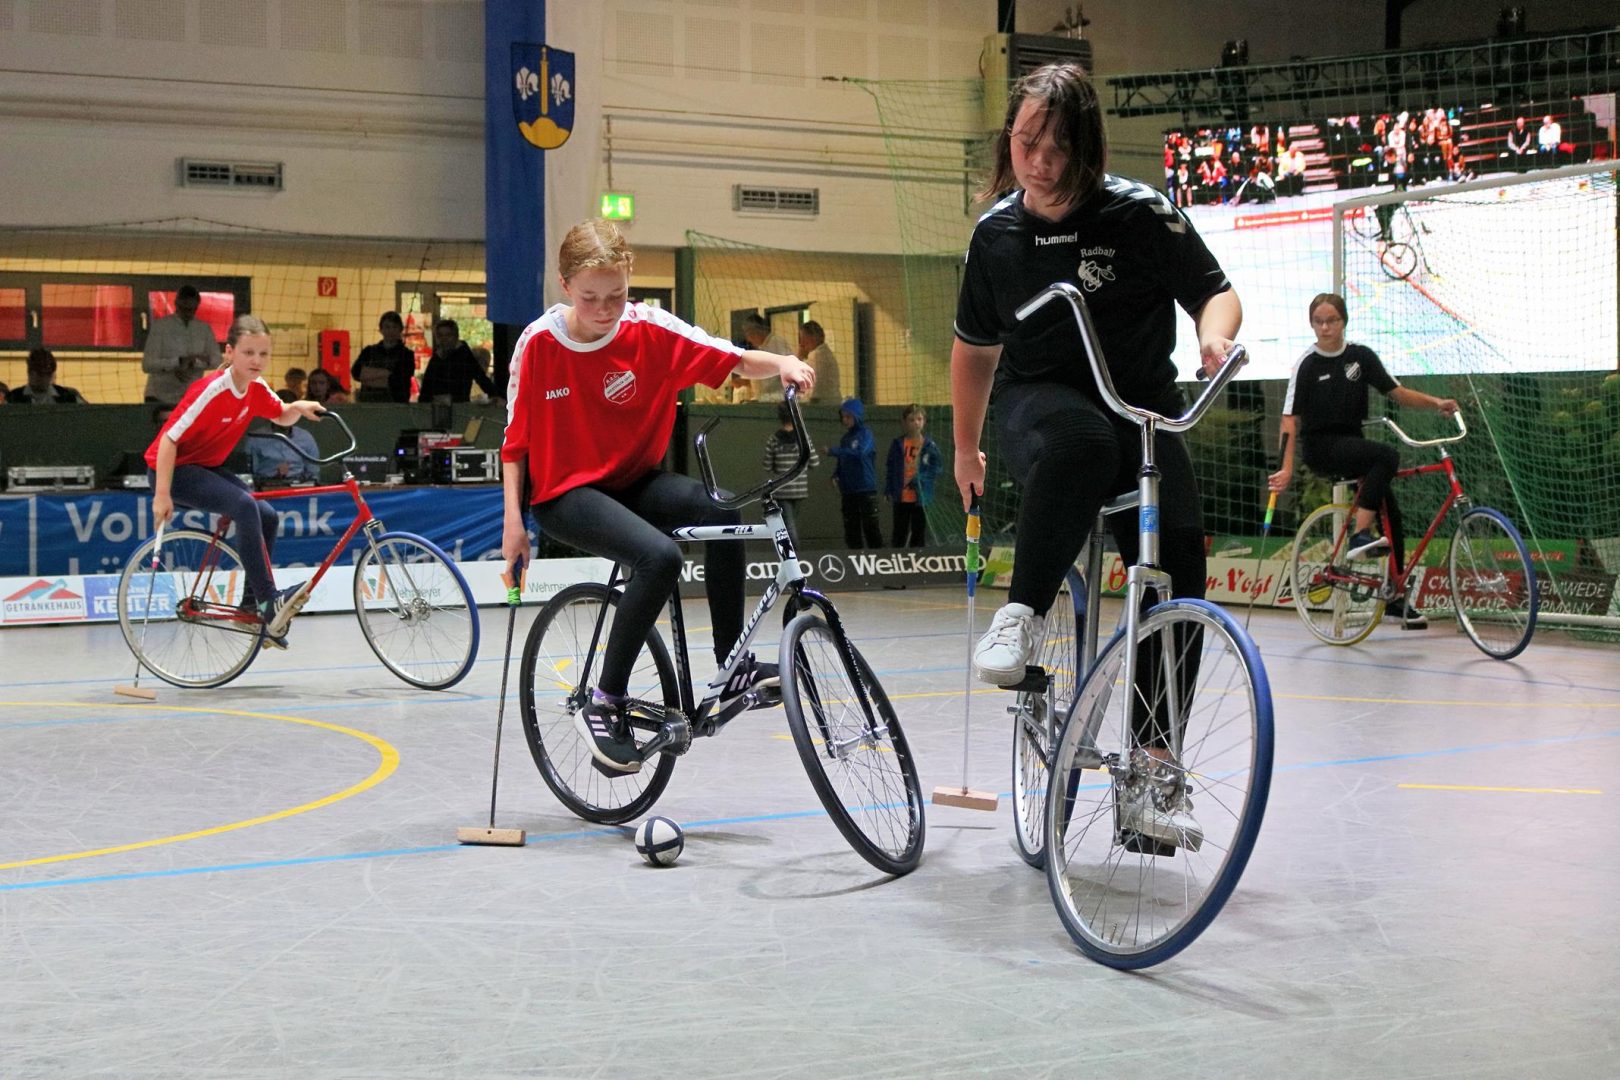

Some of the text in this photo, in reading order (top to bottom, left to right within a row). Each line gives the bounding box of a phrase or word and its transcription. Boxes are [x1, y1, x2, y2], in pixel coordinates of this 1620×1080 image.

[1035, 231, 1078, 246] hummel
[1080, 246, 1116, 258] Radball
[545, 387, 570, 400] JAKO
